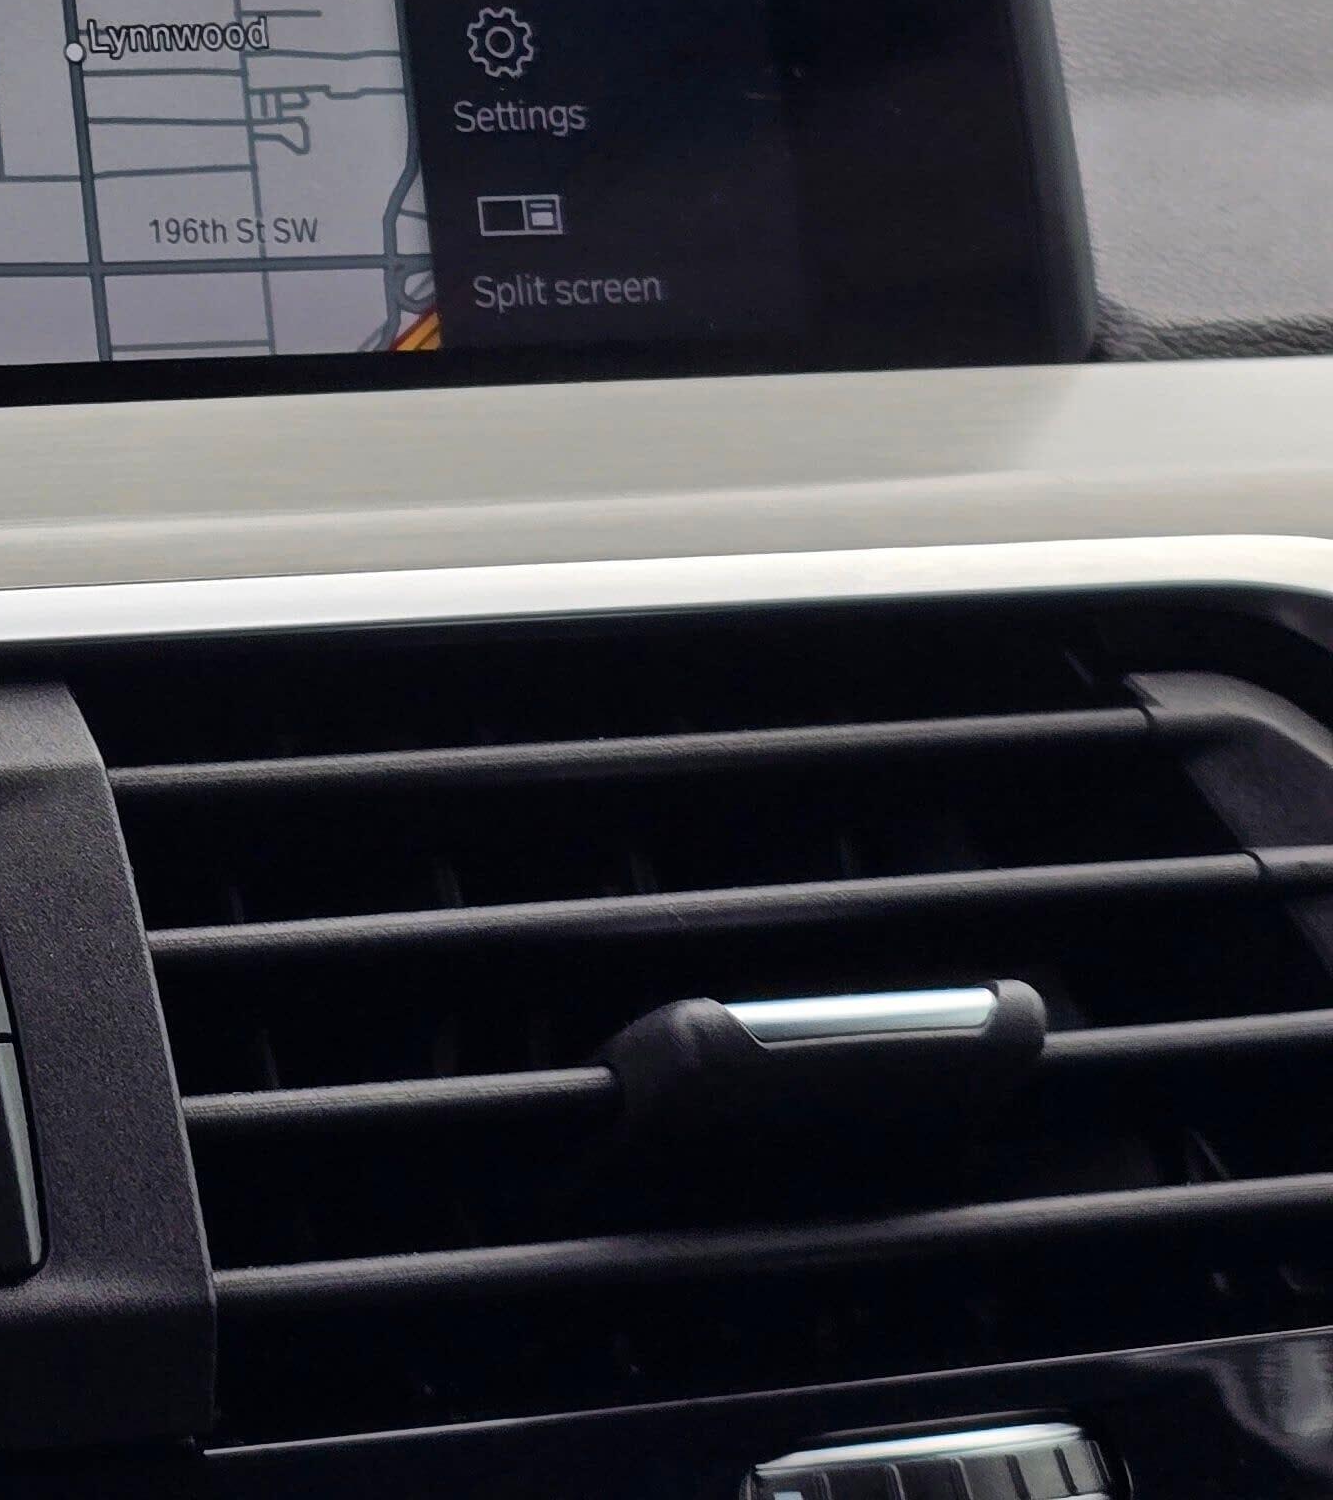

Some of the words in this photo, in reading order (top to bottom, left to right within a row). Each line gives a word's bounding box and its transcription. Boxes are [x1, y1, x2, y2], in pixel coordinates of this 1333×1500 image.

[87, 16, 269, 60] Lynnwood
[453, 100, 587, 137] Settings
[149, 217, 228, 244] 196th
[236, 218, 266, 244] St
[273, 217, 318, 244] SW
[472, 274, 547, 313] Split
[555, 276, 662, 305] screen
